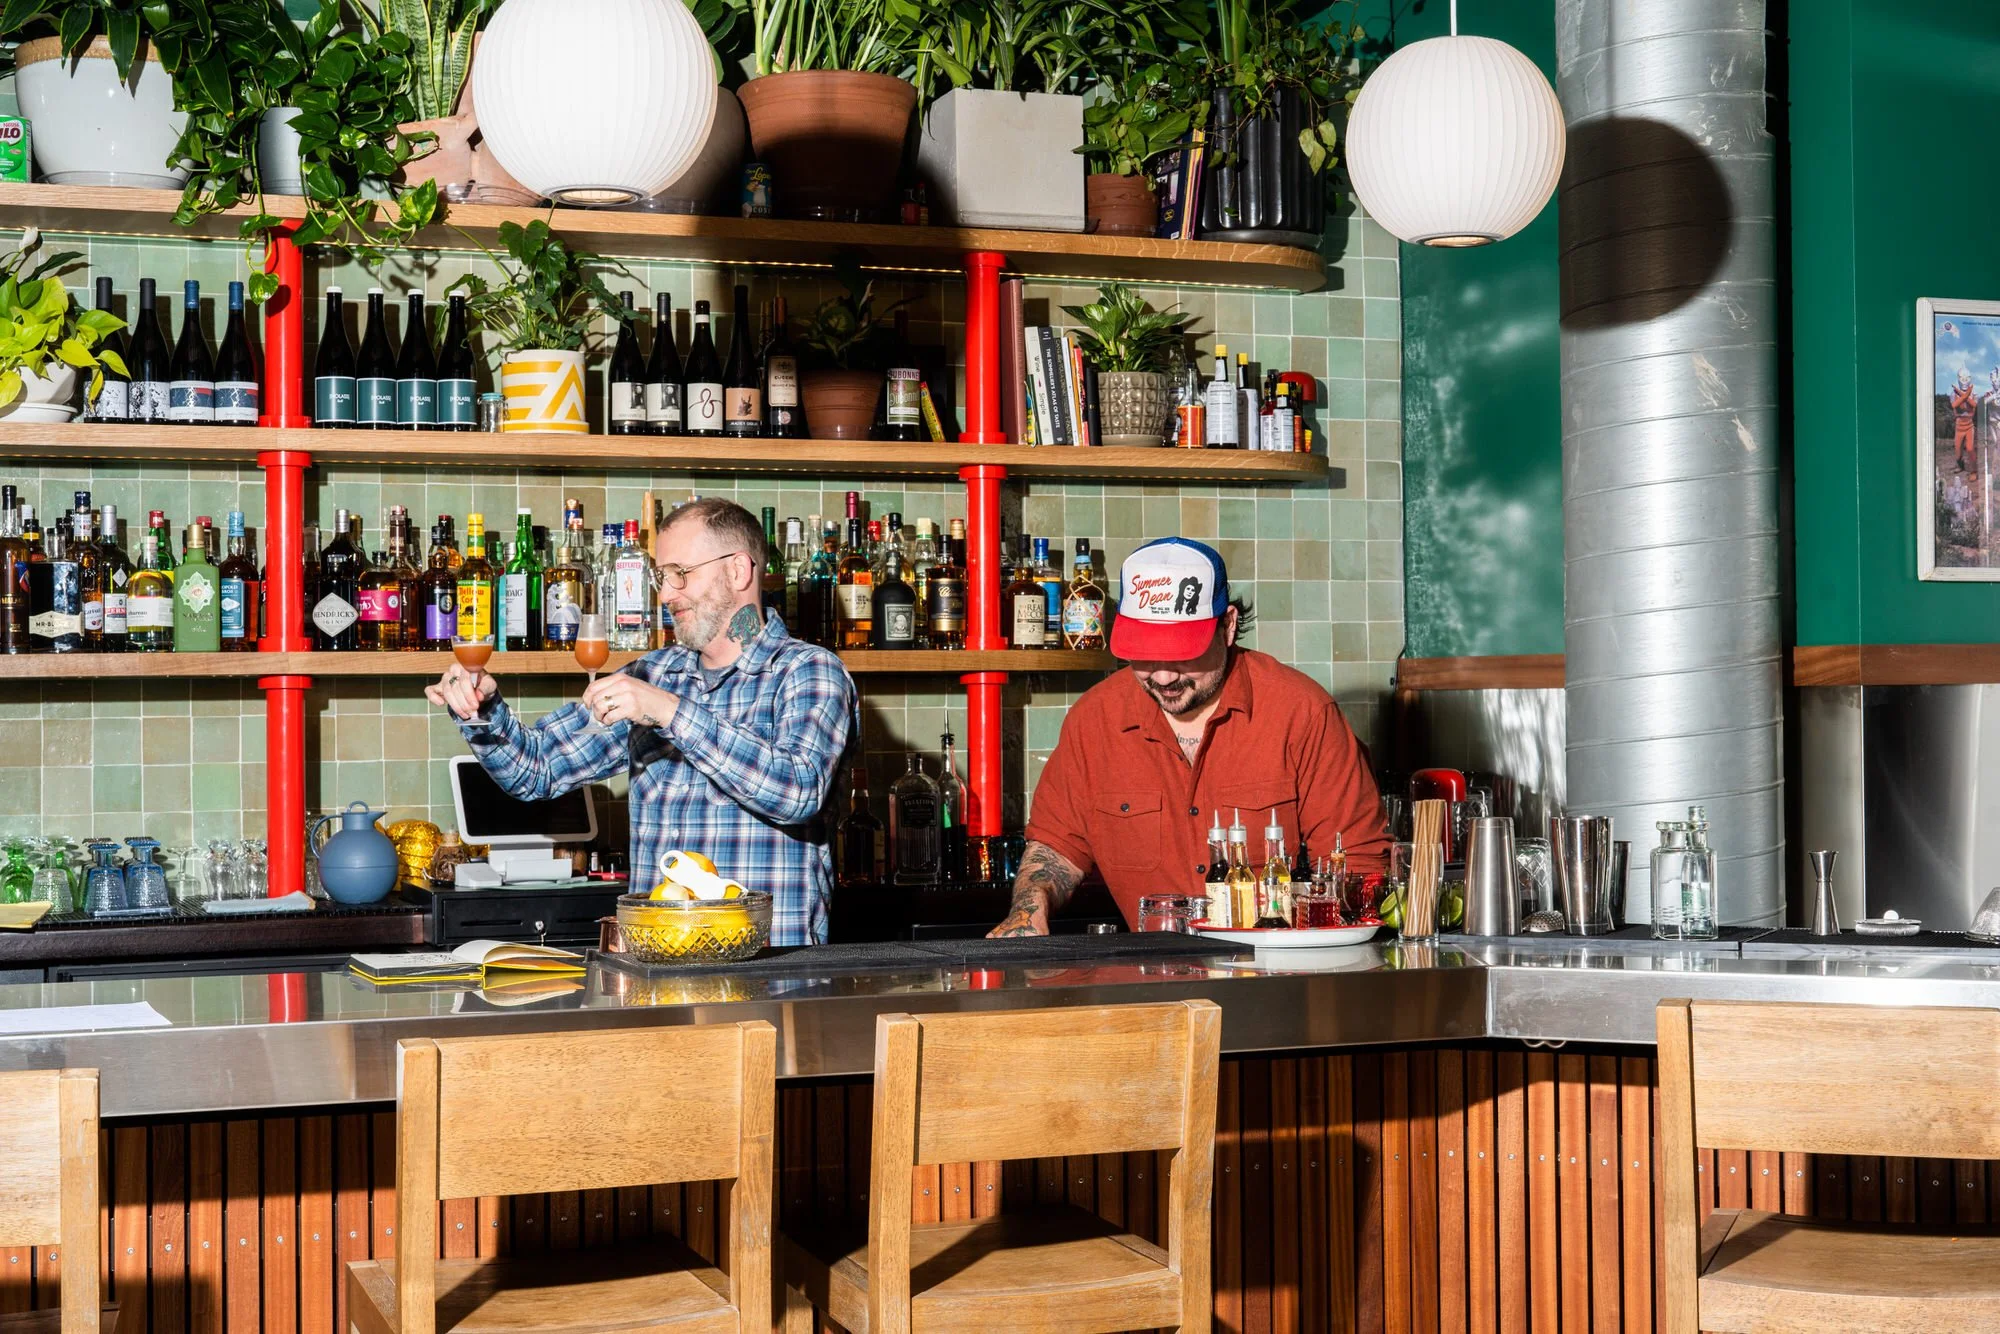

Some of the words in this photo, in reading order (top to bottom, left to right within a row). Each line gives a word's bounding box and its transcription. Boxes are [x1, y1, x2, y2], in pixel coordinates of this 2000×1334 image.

[888, 369, 920, 379] DUBONNE
[1038, 392, 1049, 415] Simple
[616, 562, 642, 570] BEEFEATER
[1130, 574, 1172, 595] Summer
[458, 587, 484, 596] Mellow
[1139, 590, 1174, 609] Dean
[1027, 603, 1044, 611] REAL
